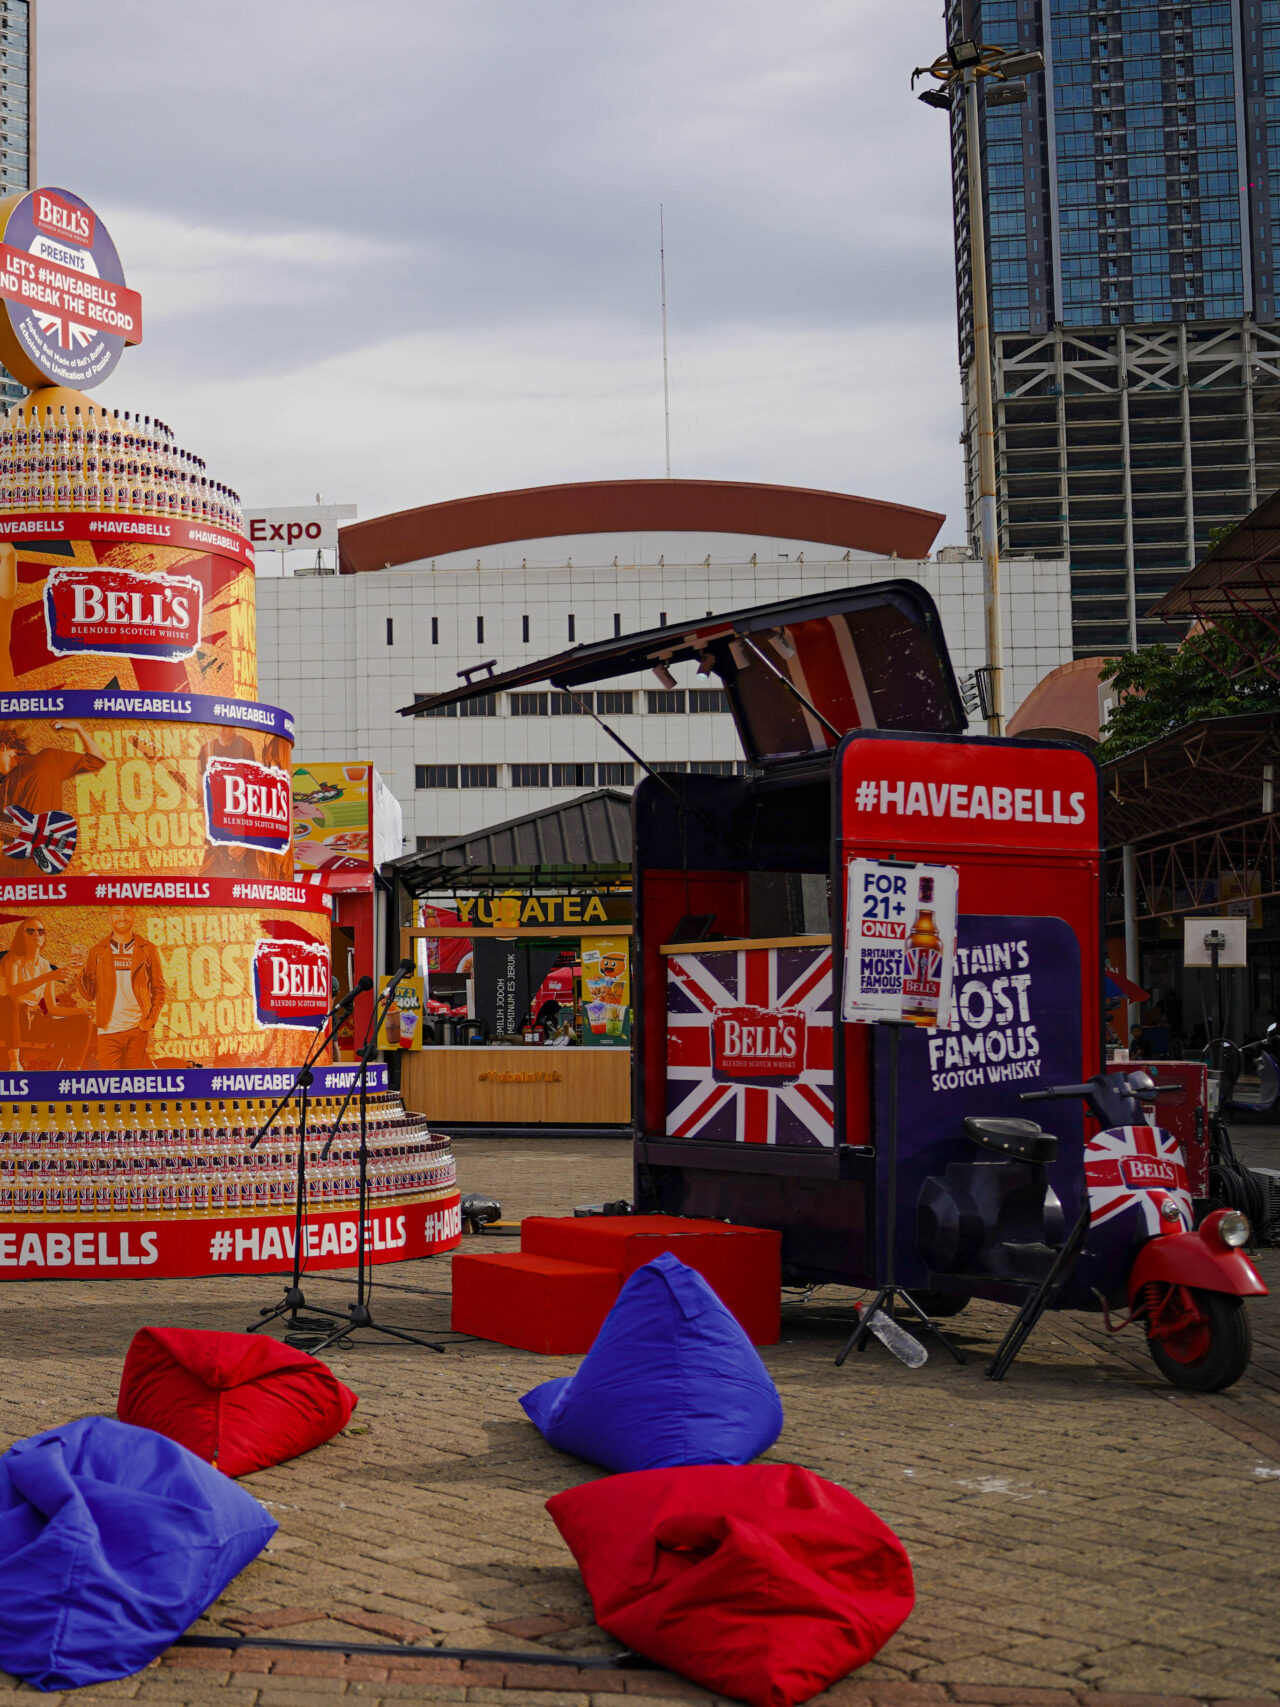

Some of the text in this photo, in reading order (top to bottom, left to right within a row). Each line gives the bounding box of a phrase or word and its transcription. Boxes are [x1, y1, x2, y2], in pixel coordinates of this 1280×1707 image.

[39, 196, 90, 237] BELL'S
[41, 243, 85, 269] PRESENTS
[7, 255, 116, 307] LET'S #HAVEABELLS
[22, 280, 60, 308] BREAK
[63, 293, 85, 316] THE
[88, 303, 133, 331] RECORD
[40, 354, 51, 368] the
[52, 363, 85, 380] Unification
[85, 368, 93, 378] of
[92, 351, 111, 374] Passion
[89, 521, 170, 536] #HAVEABELLS
[189, 529, 240, 552] #HAVEABELLS
[250, 518, 322, 545] Expo
[71, 584, 190, 629] BELL'S
[120, 628, 156, 637] SCOTCH
[159, 630, 190, 640] WHISKY
[93, 698, 192, 714] #HAVEABELLS
[213, 703, 275, 726] #HAVEABELLS
[75, 759, 199, 815] MOST
[223, 774, 288, 822] BELL'S
[855, 780, 1085, 825] #HAVEABELLS
[80, 812, 205, 850] FAMOUS
[223, 817, 253, 827] BLENDED
[254, 820, 274, 830] SCOTCH
[81, 847, 206, 872] SCOTCH WHISKY
[95, 882, 210, 900] #HAVEABELLS
[232, 883, 306, 904] #HAVEABELLS
[863, 873, 907, 895] FOR
[455, 897, 608, 924] YUBATEA
[862, 896, 906, 919] 21+
[146, 912, 262, 946] BRITAIN'S
[862, 921, 905, 939] ONLY
[860, 958, 902, 976] MOST
[861, 948, 903, 959] BRITAIN'S
[270, 957, 328, 997] BELL'S
[860, 975, 902, 988] FAMOUS
[906, 980, 937, 994] BELL'S
[270, 1000, 296, 1008] BLENDED
[297, 1000, 316, 1008] SCOTCH
[496, 979, 505, 1007] JODOH
[507, 953, 516, 1034] MEMINUM ES JERUK
[152, 997, 264, 1040] FAMOU
[155, 1038, 210, 1060] SCOTCH
[723, 1019, 797, 1058] BELL'S
[928, 1025, 1040, 1071] FAMOUS
[749, 1060, 771, 1068] SCOTCH
[931, 1059, 1041, 1091] SCOTCH WHISKY
[58, 1075, 185, 1095] #HAVEABELLS
[1129, 1160, 1175, 1182] BELL'S
[209, 1215, 406, 1262] #HAVEABELLS
